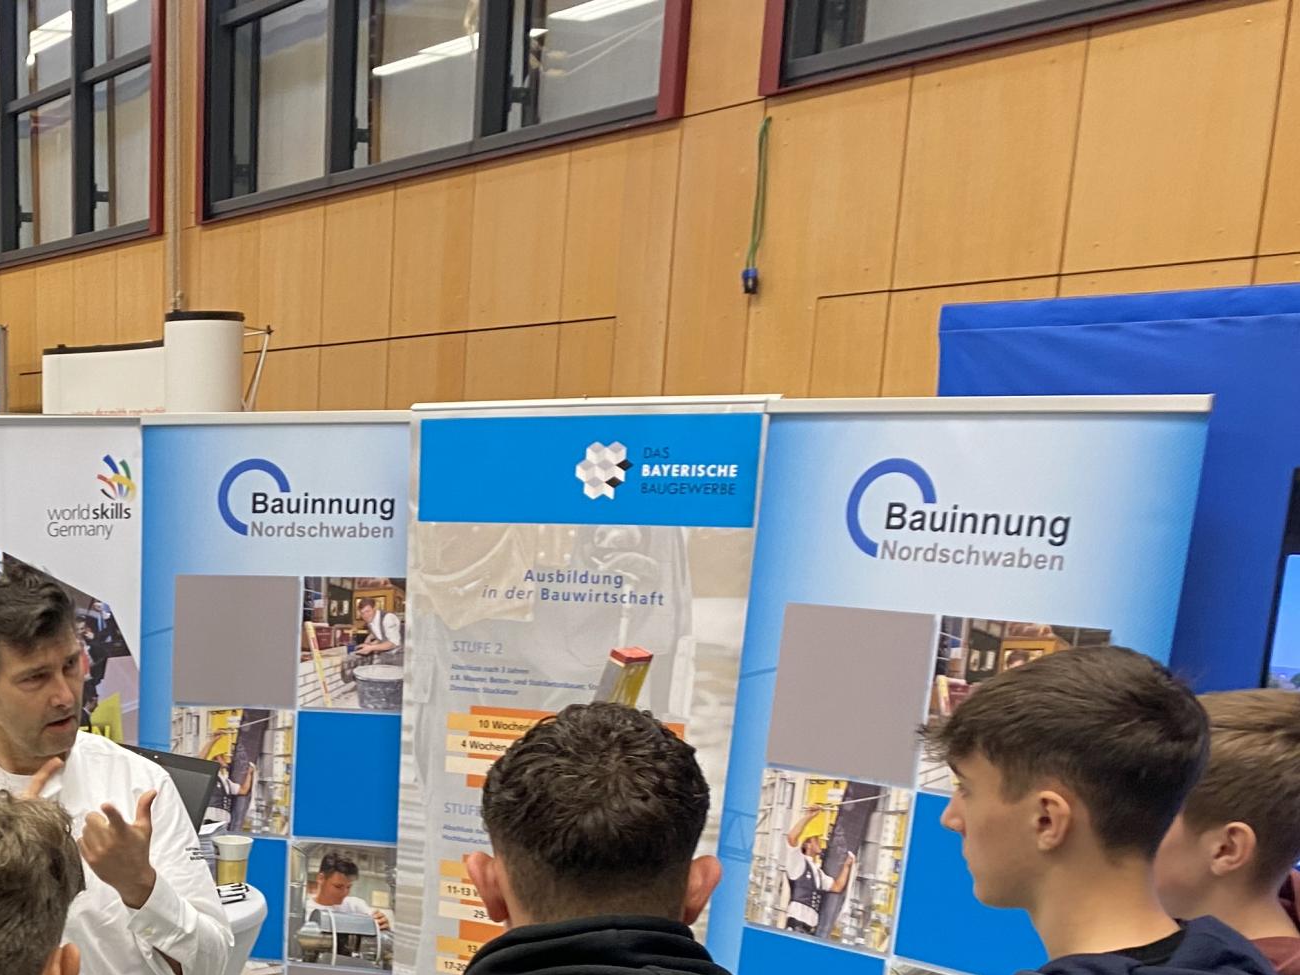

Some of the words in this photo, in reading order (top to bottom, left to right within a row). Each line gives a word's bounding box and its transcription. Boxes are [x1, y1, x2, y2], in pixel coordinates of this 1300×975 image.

[643, 447, 670, 459] DAS
[641, 464, 739, 478] BAYERISCHE
[640, 482, 737, 496] BAUGEWERBE
[251, 492, 396, 521] Bauinnung
[47, 522, 114, 540] Germany
[250, 522, 395, 539] Nordschwaben
[884, 502, 1072, 547] Bauinnung
[880, 539, 1066, 572] Nordschwaben
[523, 569, 625, 588] Ausbildung
[482, 584, 498, 599] in
[505, 586, 535, 601] der
[540, 588, 665, 607] Bauwirtschaft
[452, 640, 491, 654] STUFE
[494, 643, 503, 655] 2
[479, 719, 489, 729] 10
[492, 721, 531, 732] Wochen
[461, 739, 467, 748] 4
[447, 885, 471, 897] 11-13
[473, 909, 488, 919] 29-
